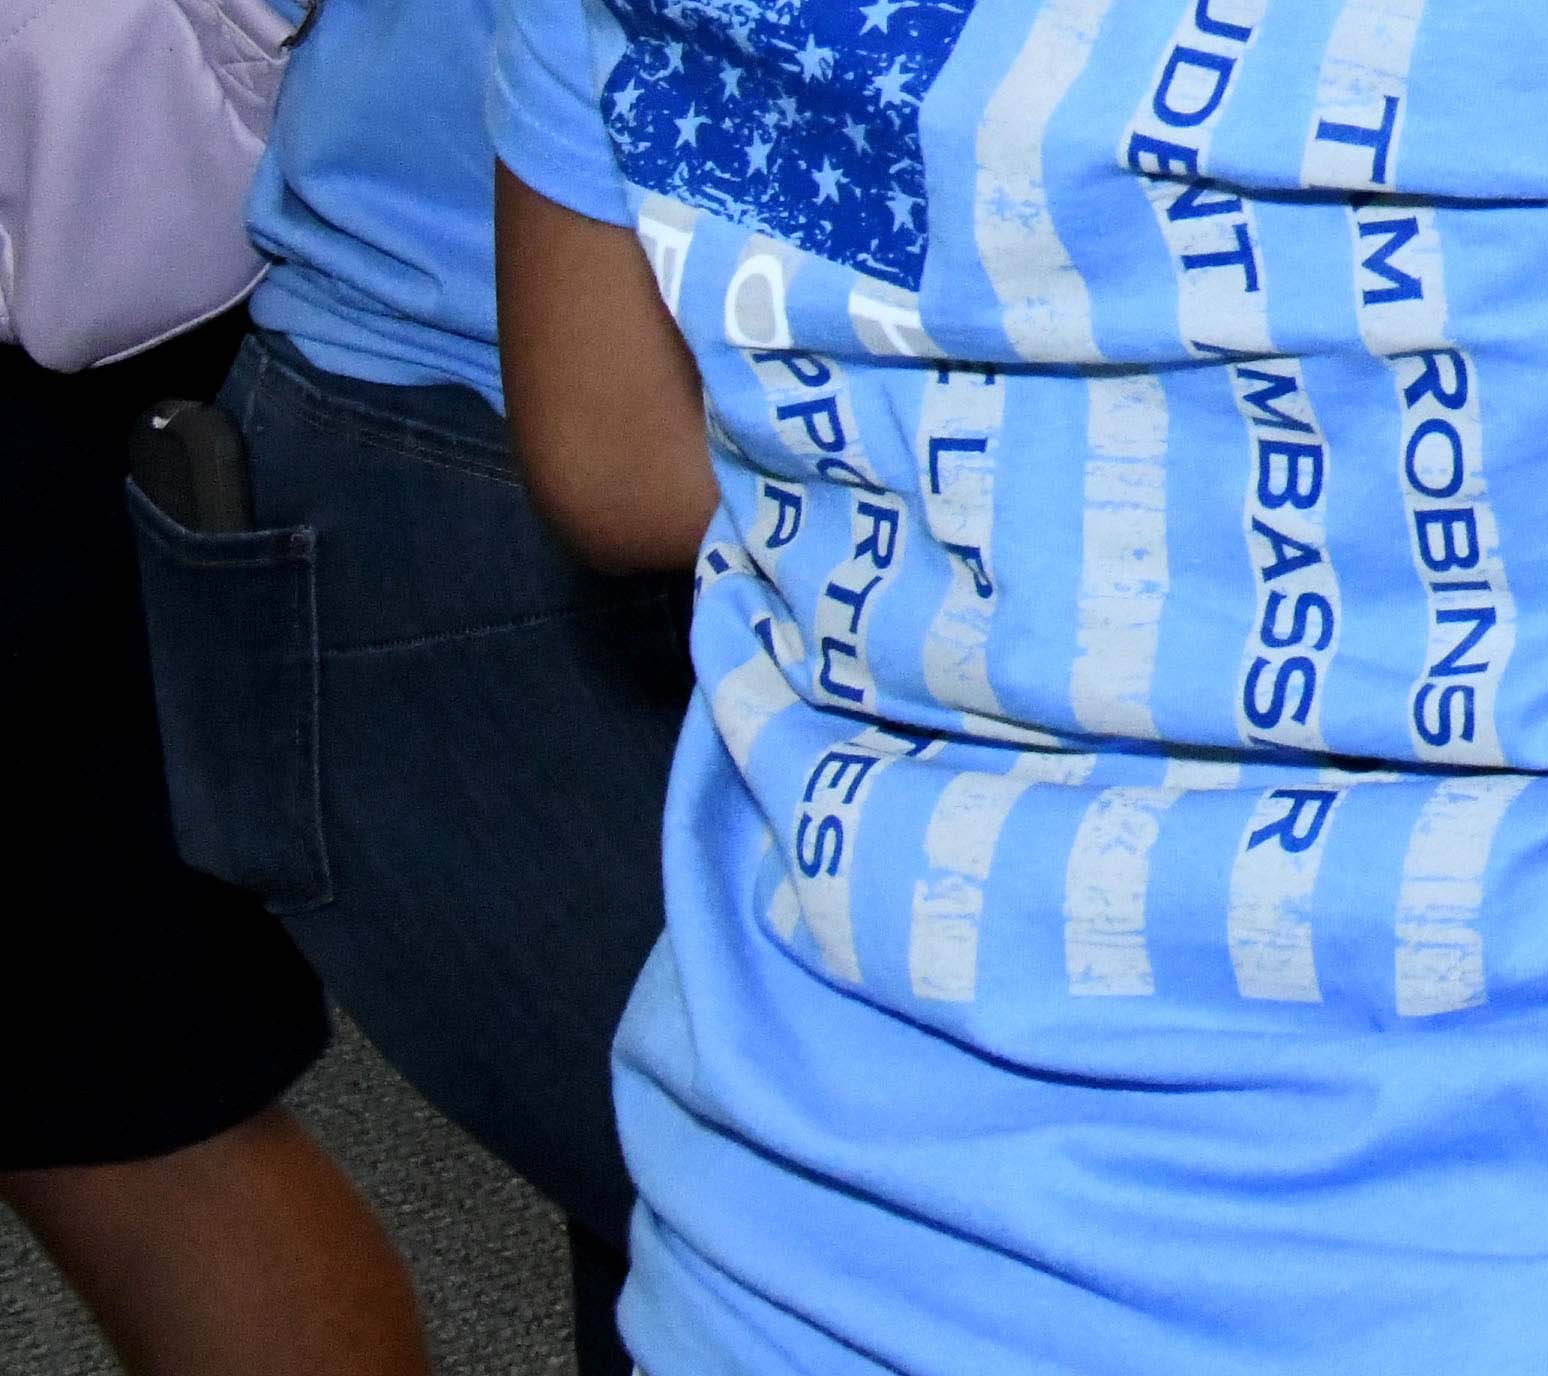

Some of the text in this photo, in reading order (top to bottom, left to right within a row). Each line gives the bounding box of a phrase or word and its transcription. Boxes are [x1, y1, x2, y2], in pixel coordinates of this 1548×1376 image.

[1191, 340, 1338, 854] MBASSR
[1314, 95, 1500, 747] TM ROBINS
